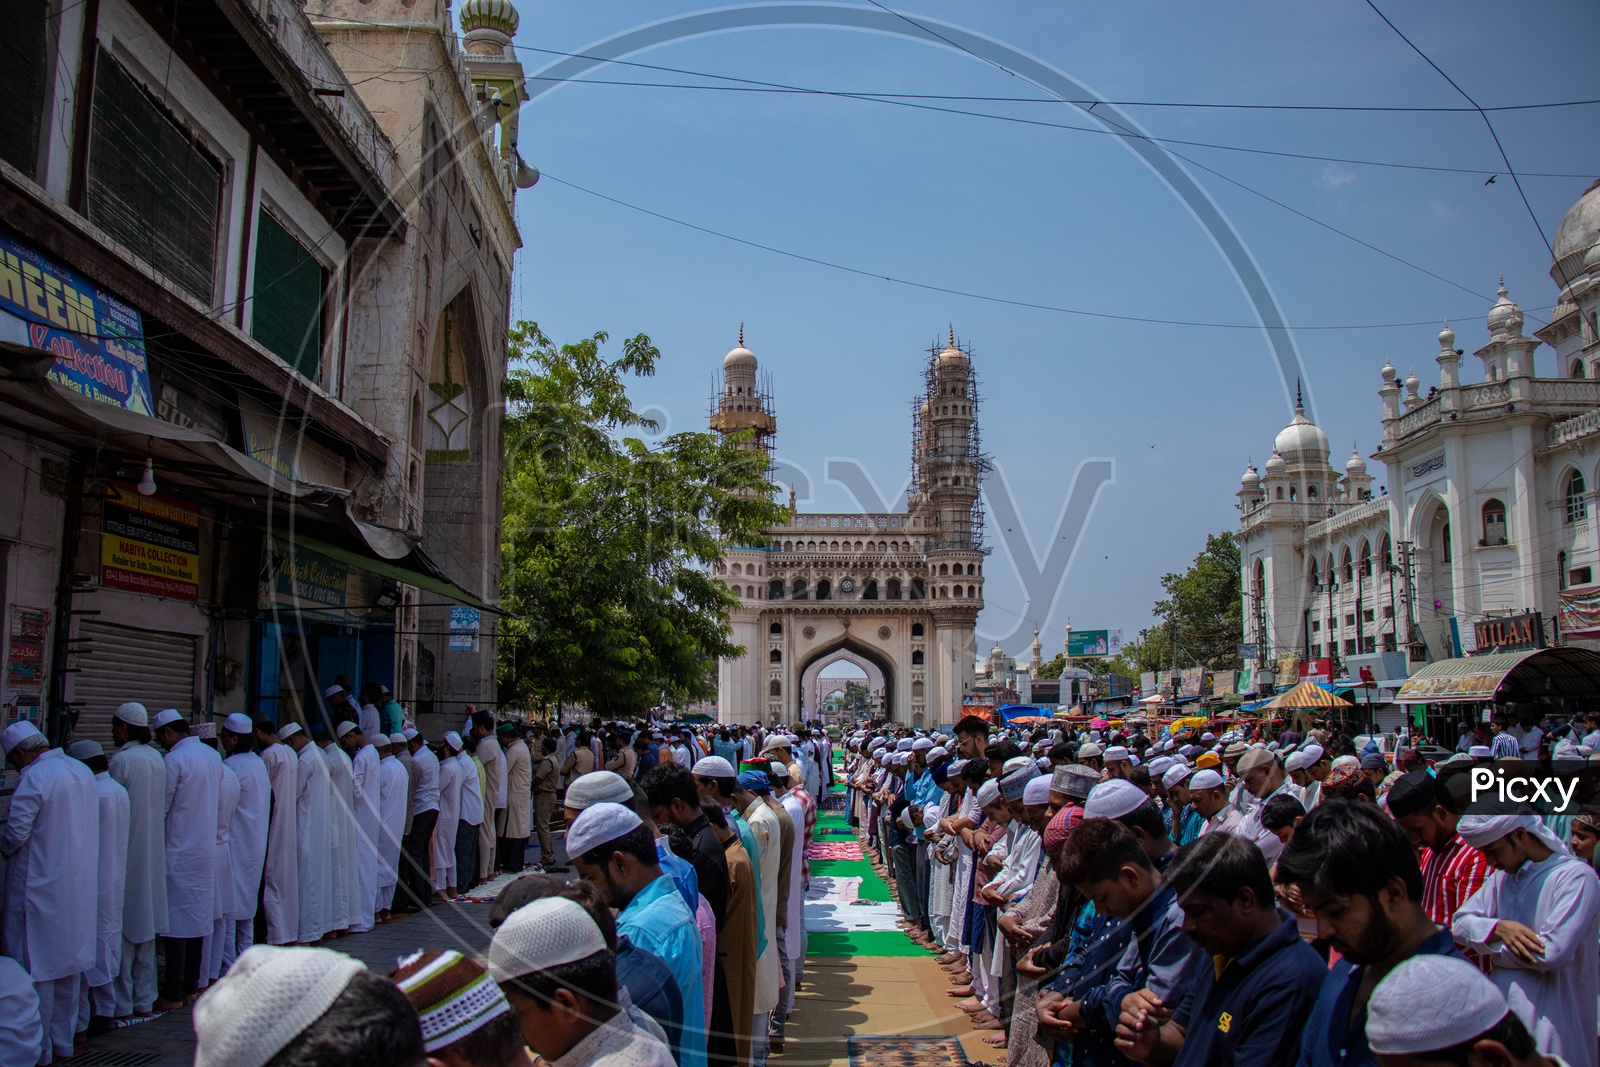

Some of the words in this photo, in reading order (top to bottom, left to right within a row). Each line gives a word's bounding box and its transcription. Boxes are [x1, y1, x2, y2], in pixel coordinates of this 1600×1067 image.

[30, 323, 127, 395] Collection
[59, 373, 82, 395] Wear
[85, 383, 92, 398] &
[112, 554, 130, 566] Retailer
[119, 541, 146, 558] NABIYA
[147, 548, 188, 567] COLLECTION
[310, 561, 346, 592] Collection
[1476, 618, 1534, 650] MILAN
